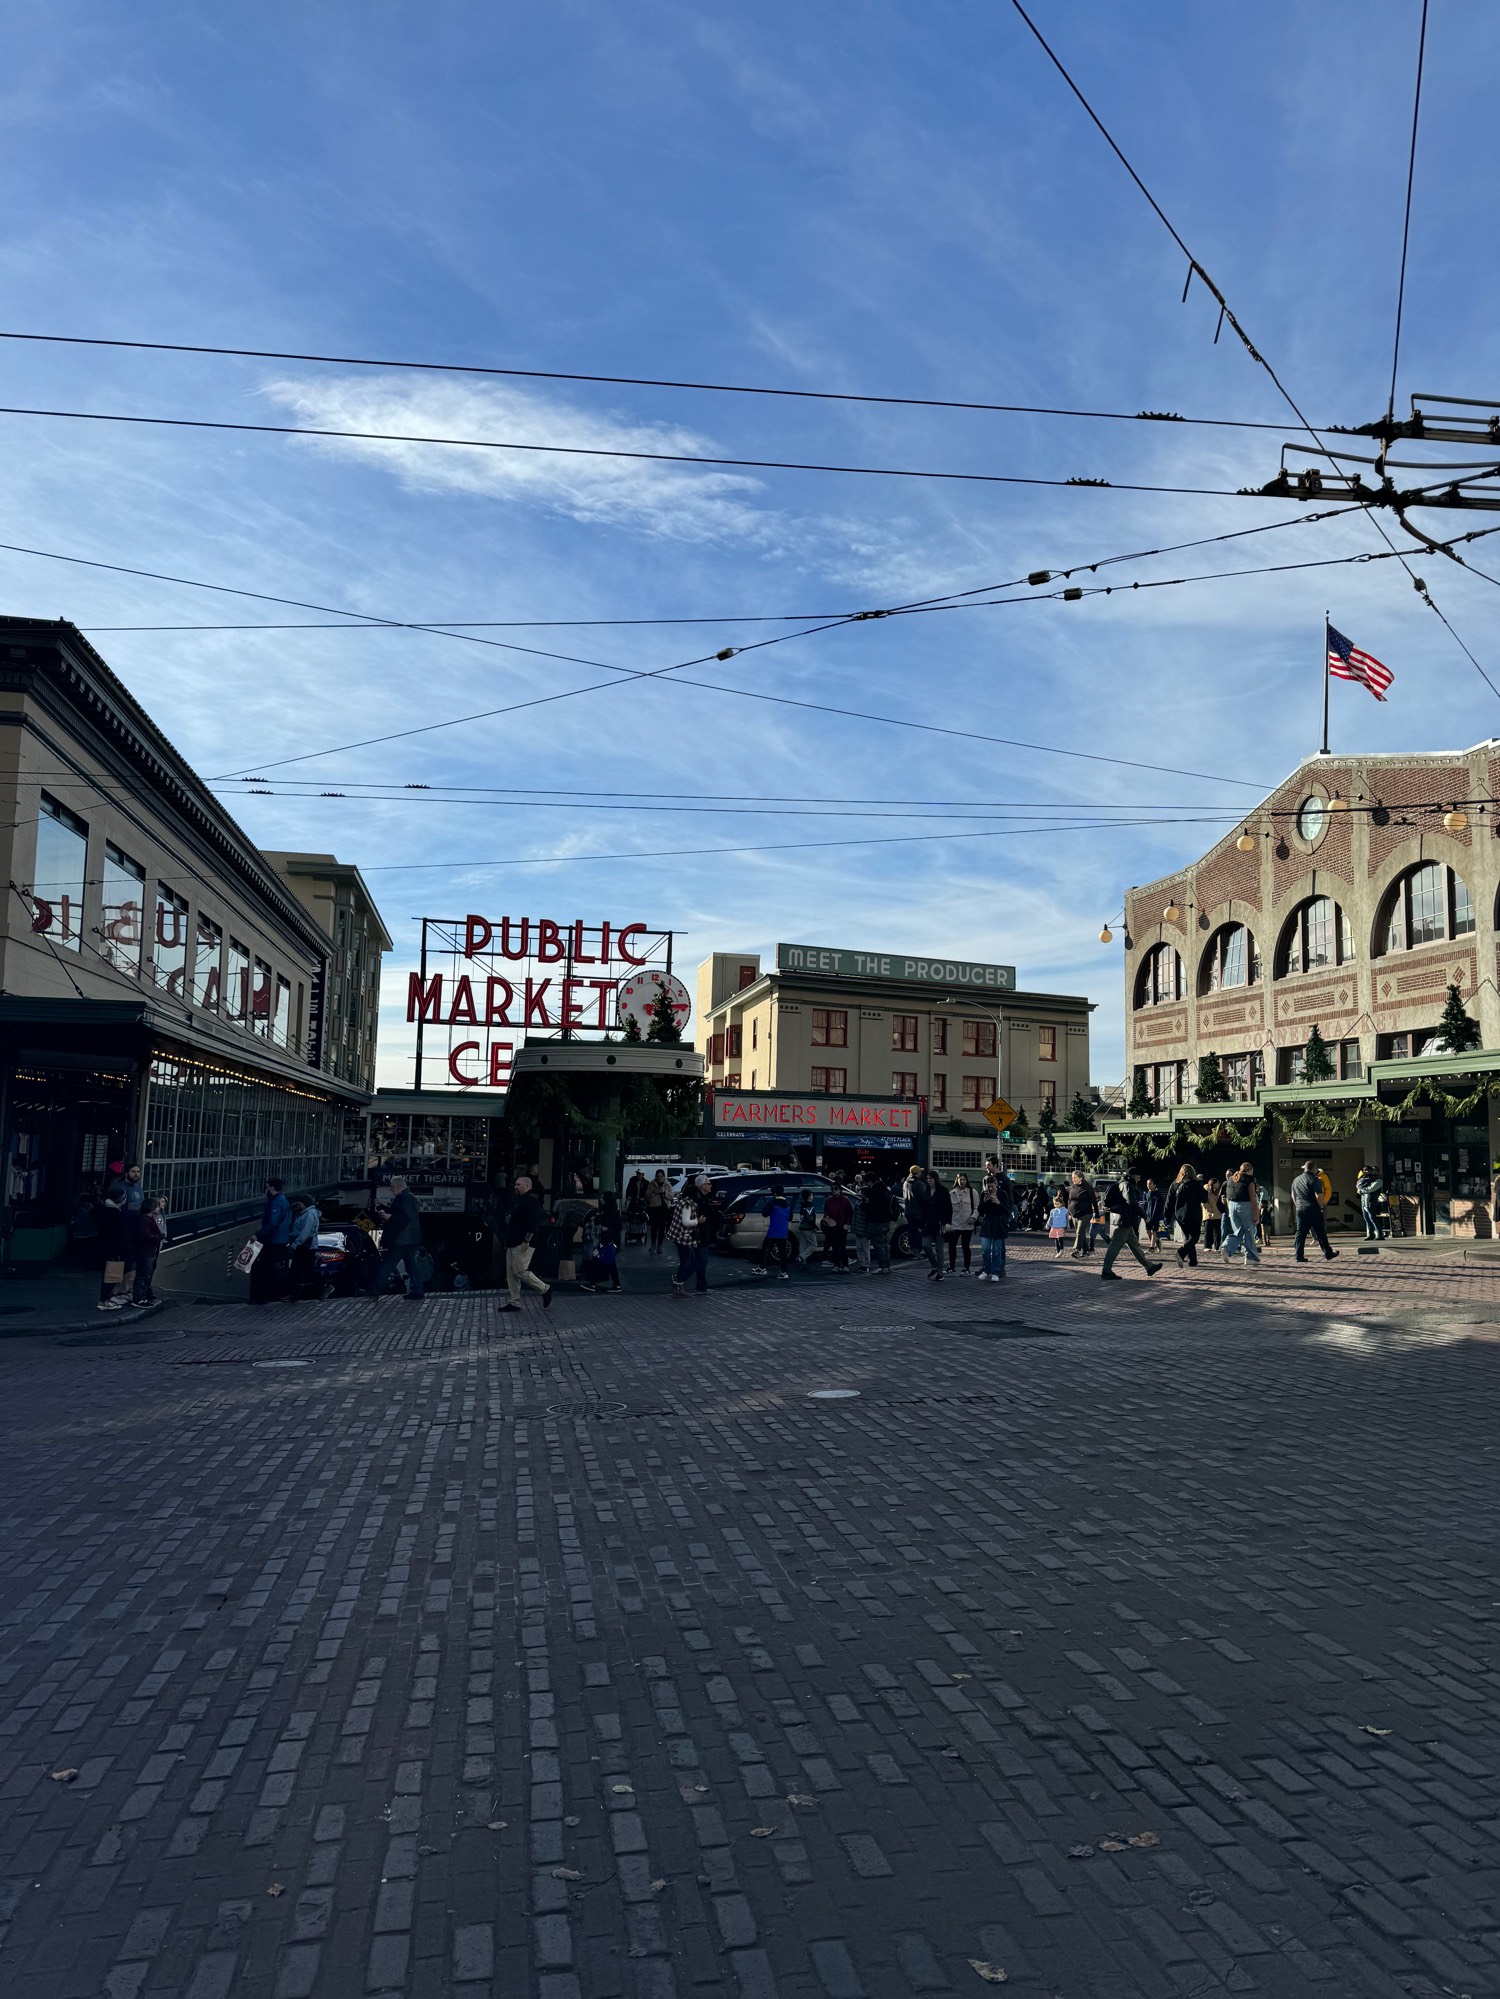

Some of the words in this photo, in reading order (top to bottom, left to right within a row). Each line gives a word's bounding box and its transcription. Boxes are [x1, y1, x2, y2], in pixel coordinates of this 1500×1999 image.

[465, 914, 647, 966] PUBLIC
[788, 948, 842, 970] MEET
[854, 955, 891, 975] THE
[904, 960, 1008, 985] PRODUCER
[406, 971, 618, 1030] MARKET
[1241, 1027, 1311, 1050] CORNER
[1322, 1011, 1401, 1039] MARKET
[722, 1101, 817, 1125] FARMERS
[829, 1105, 912, 1128] MARKET
[424, 1174, 465, 1183] THEATER
